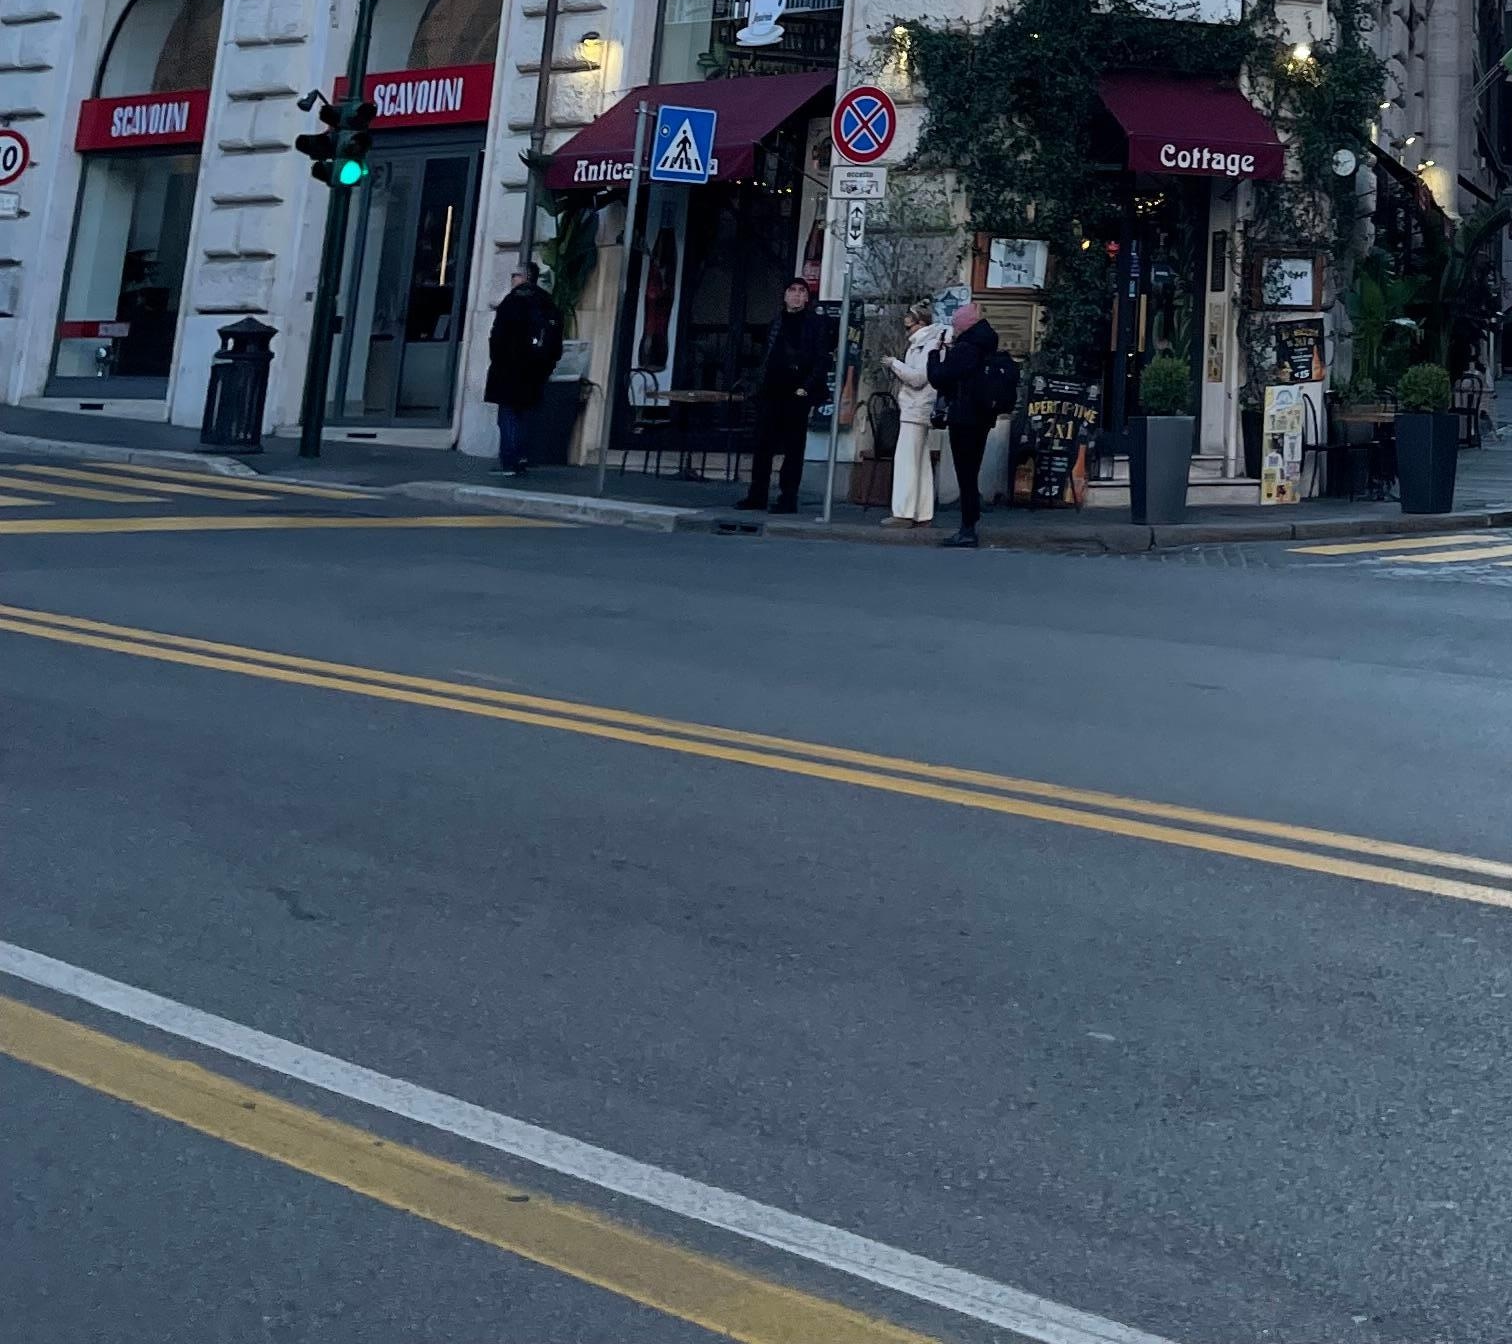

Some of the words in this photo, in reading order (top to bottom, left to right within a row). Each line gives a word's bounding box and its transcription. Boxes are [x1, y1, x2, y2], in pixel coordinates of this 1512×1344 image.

[372, 77, 464, 117] SCAVOLINI
[111, 101, 190, 138] SCAVOLINI
[573, 159, 633, 183] Antica
[1160, 143, 1255, 176] Cottage
